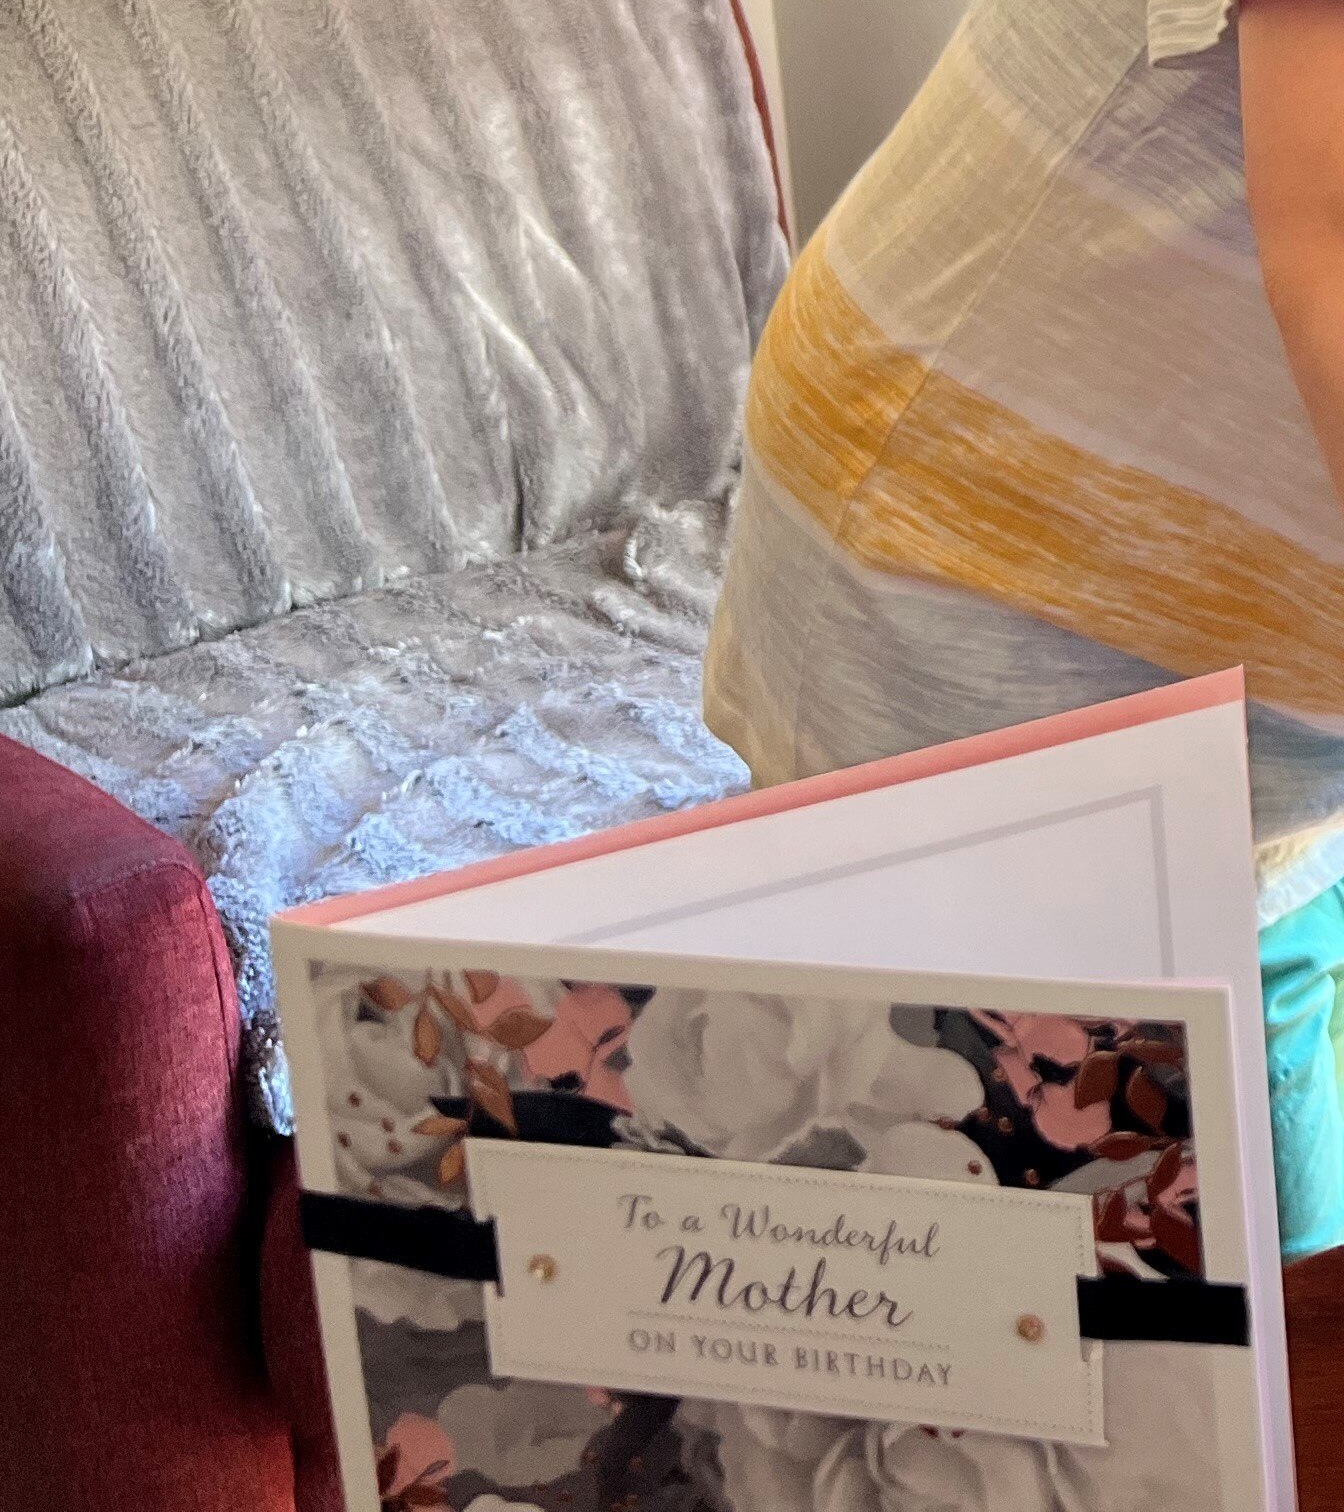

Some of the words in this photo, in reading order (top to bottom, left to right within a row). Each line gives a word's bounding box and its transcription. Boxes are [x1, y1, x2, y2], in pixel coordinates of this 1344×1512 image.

[619, 1194, 665, 1231] To
[679, 1215, 703, 1234] a
[719, 1204, 940, 1267] Wonderful
[656, 1245, 912, 1328] Mother
[626, 1328, 676, 1354] ON
[690, 1334, 779, 1367] YOUR
[794, 1346, 952, 1387] BIRTHDAY
